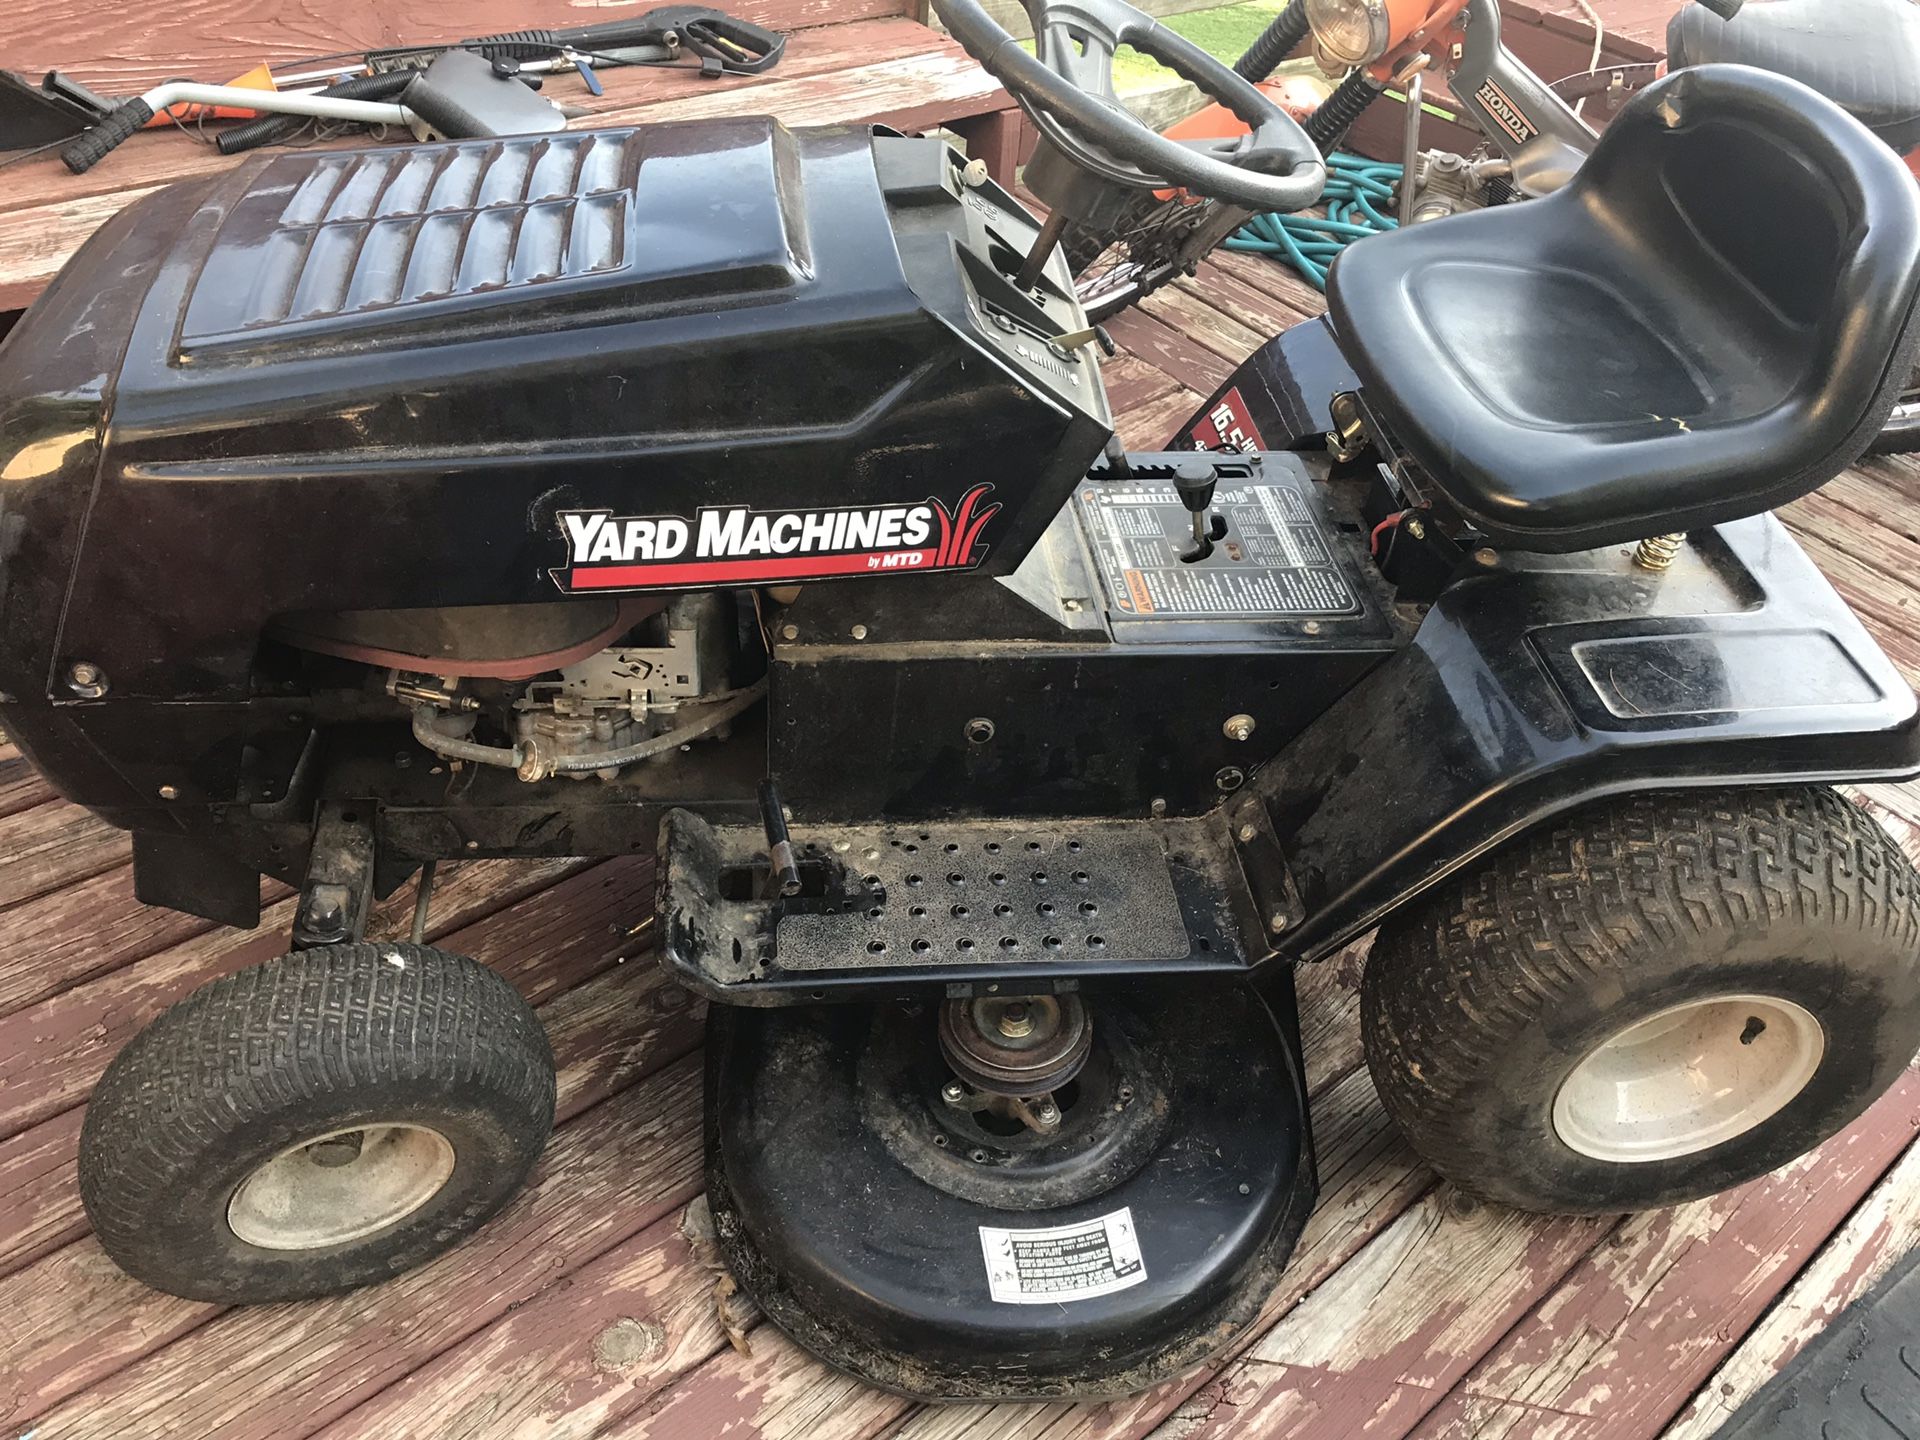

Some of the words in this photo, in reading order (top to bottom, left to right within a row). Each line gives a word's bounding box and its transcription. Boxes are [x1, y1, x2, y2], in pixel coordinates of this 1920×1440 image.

[1479, 85, 1529, 140] HONDA
[1210, 403, 1244, 451] 16.5
[564, 514, 688, 562] YARD
[696, 506, 931, 558] MACHINES
[867, 555, 881, 569] by
[882, 552, 923, 567] MTD
